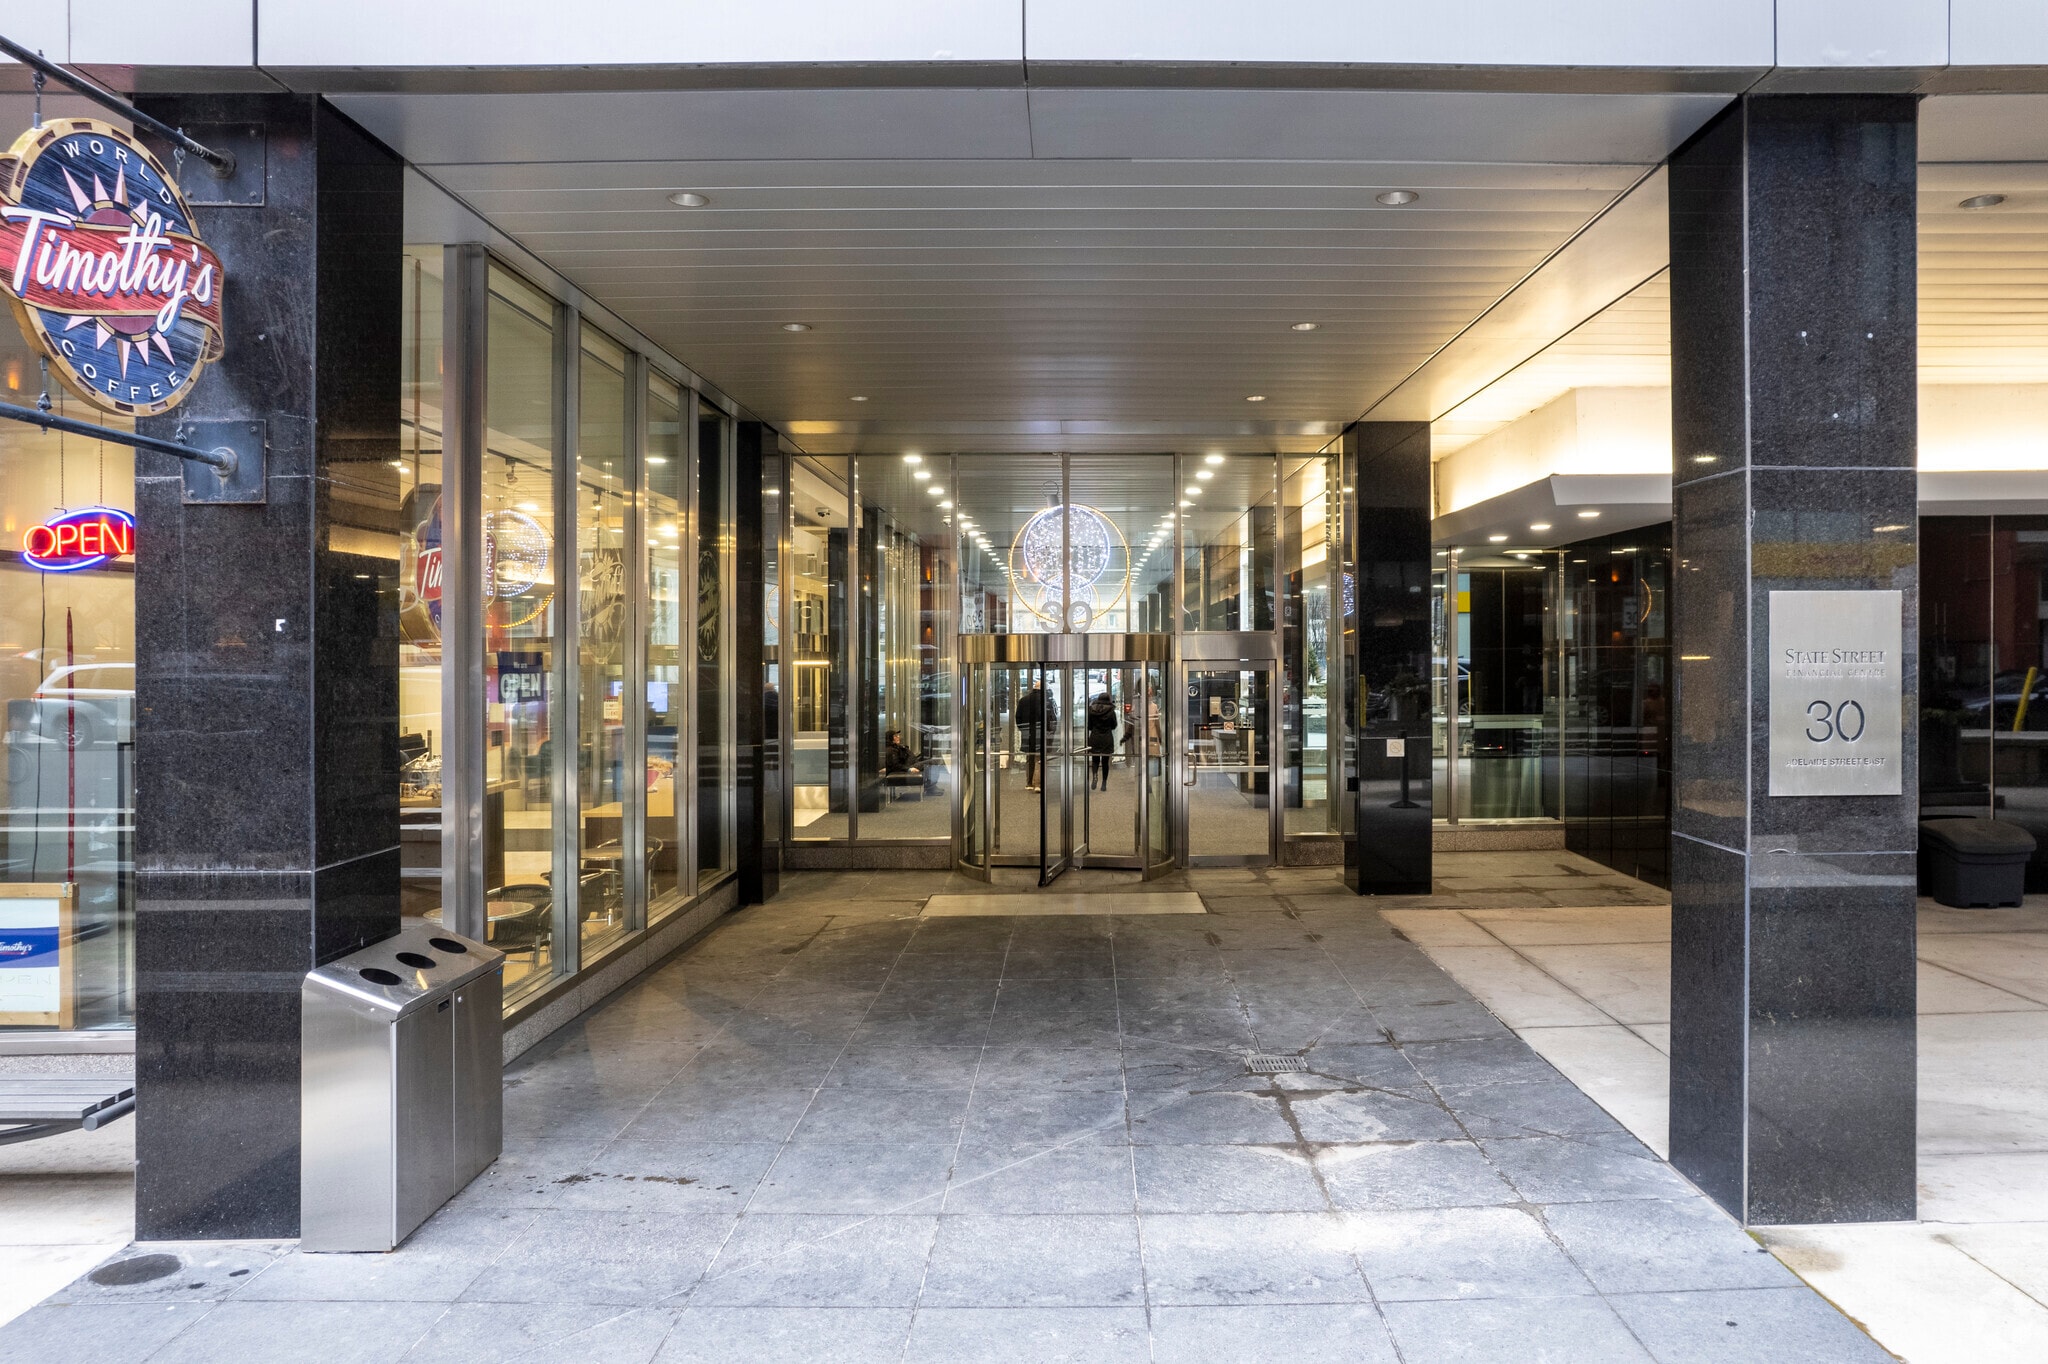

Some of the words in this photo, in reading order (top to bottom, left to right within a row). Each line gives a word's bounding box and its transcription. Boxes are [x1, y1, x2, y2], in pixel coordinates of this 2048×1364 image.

[62, 138, 174, 206] WORLD
[1, 206, 214, 337] Timothy's
[61, 338, 182, 400] COFFEE
[23, 520, 129, 559] OPEN
[1040, 601, 1093, 633] 30
[1785, 648, 1829, 664] STATE
[1832, 648, 1887, 664] STREET
[1785, 668, 1843, 678] FINANCIAL
[501, 673, 541, 699] OPEN
[1806, 699, 1865, 743] 30
[1786, 758, 1828, 767] ADELAIDE
[1829, 758, 1863, 767] STREET
[1863, 757, 1886, 766] EAST
